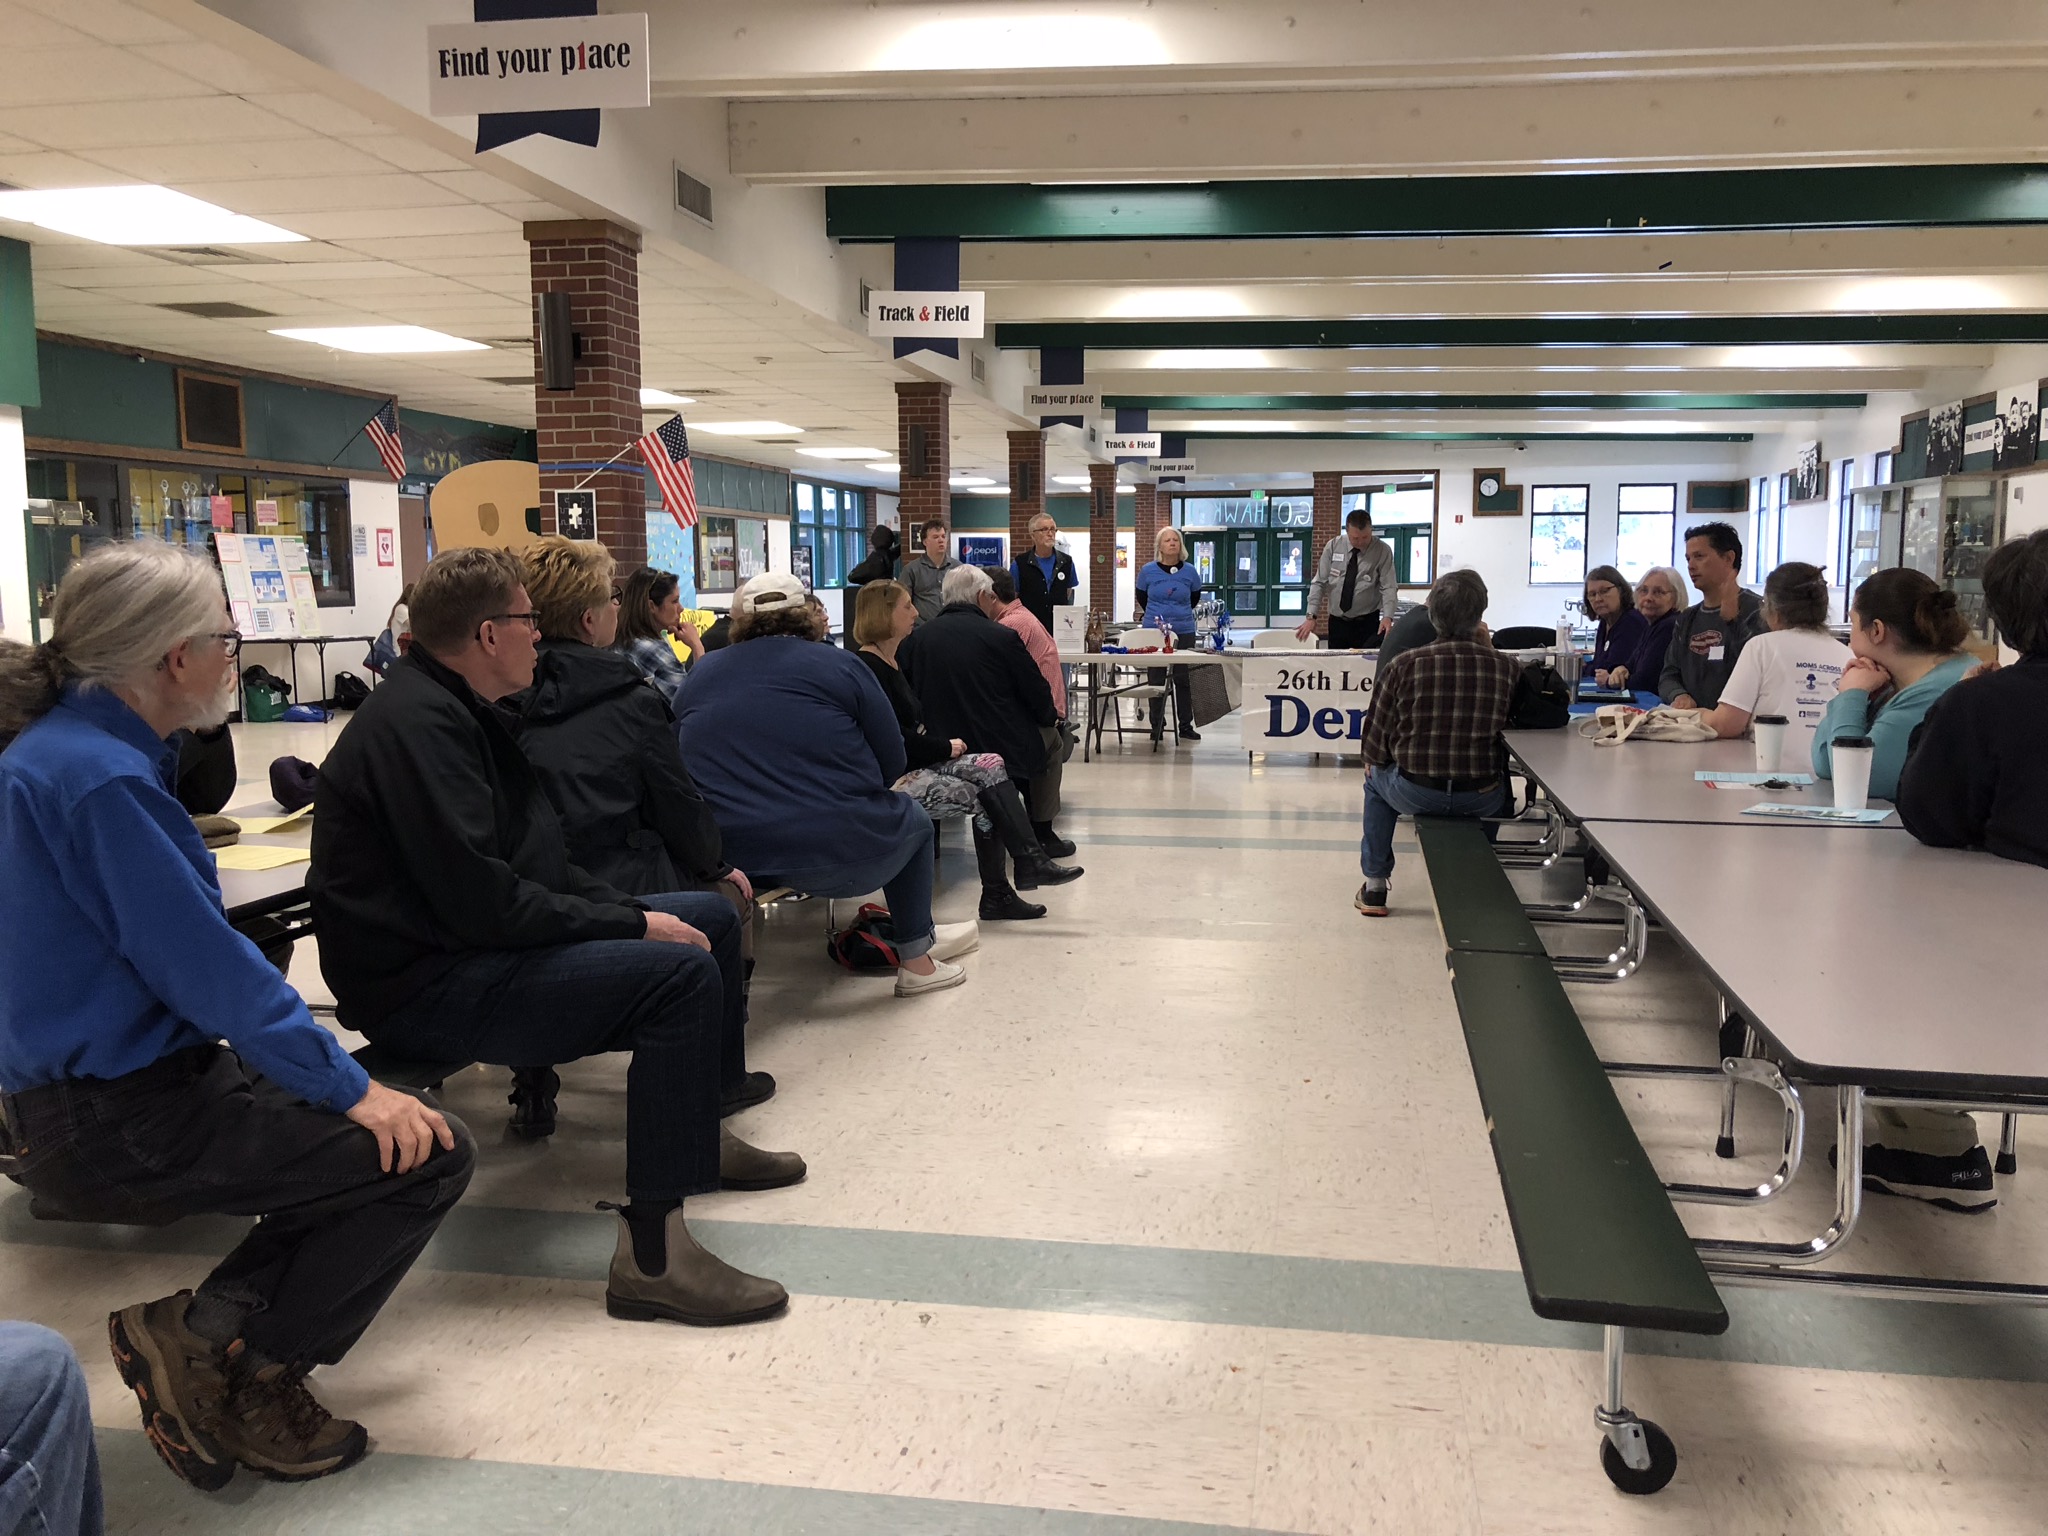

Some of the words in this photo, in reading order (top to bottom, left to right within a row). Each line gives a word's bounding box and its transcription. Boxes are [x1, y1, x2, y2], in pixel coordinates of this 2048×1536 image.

[438, 47, 489, 78] Find
[496, 47, 552, 79] your
[879, 305, 915, 321] Track
[919, 305, 930, 321] &
[934, 305, 970, 321] Field
[1031, 394, 1047, 404] Find
[1049, 395, 1067, 405] your
[1105, 440, 1126, 449] Track
[1129, 440, 1135, 449] &
[1137, 440, 1156, 449] Field
[1149, 464, 1161, 472] Find
[1163, 464, 1176, 472] your
[974, 546, 997, 555] pepsi
[1277, 669, 1331, 691] 26th
[1952, 1168, 1982, 1183] FILA
